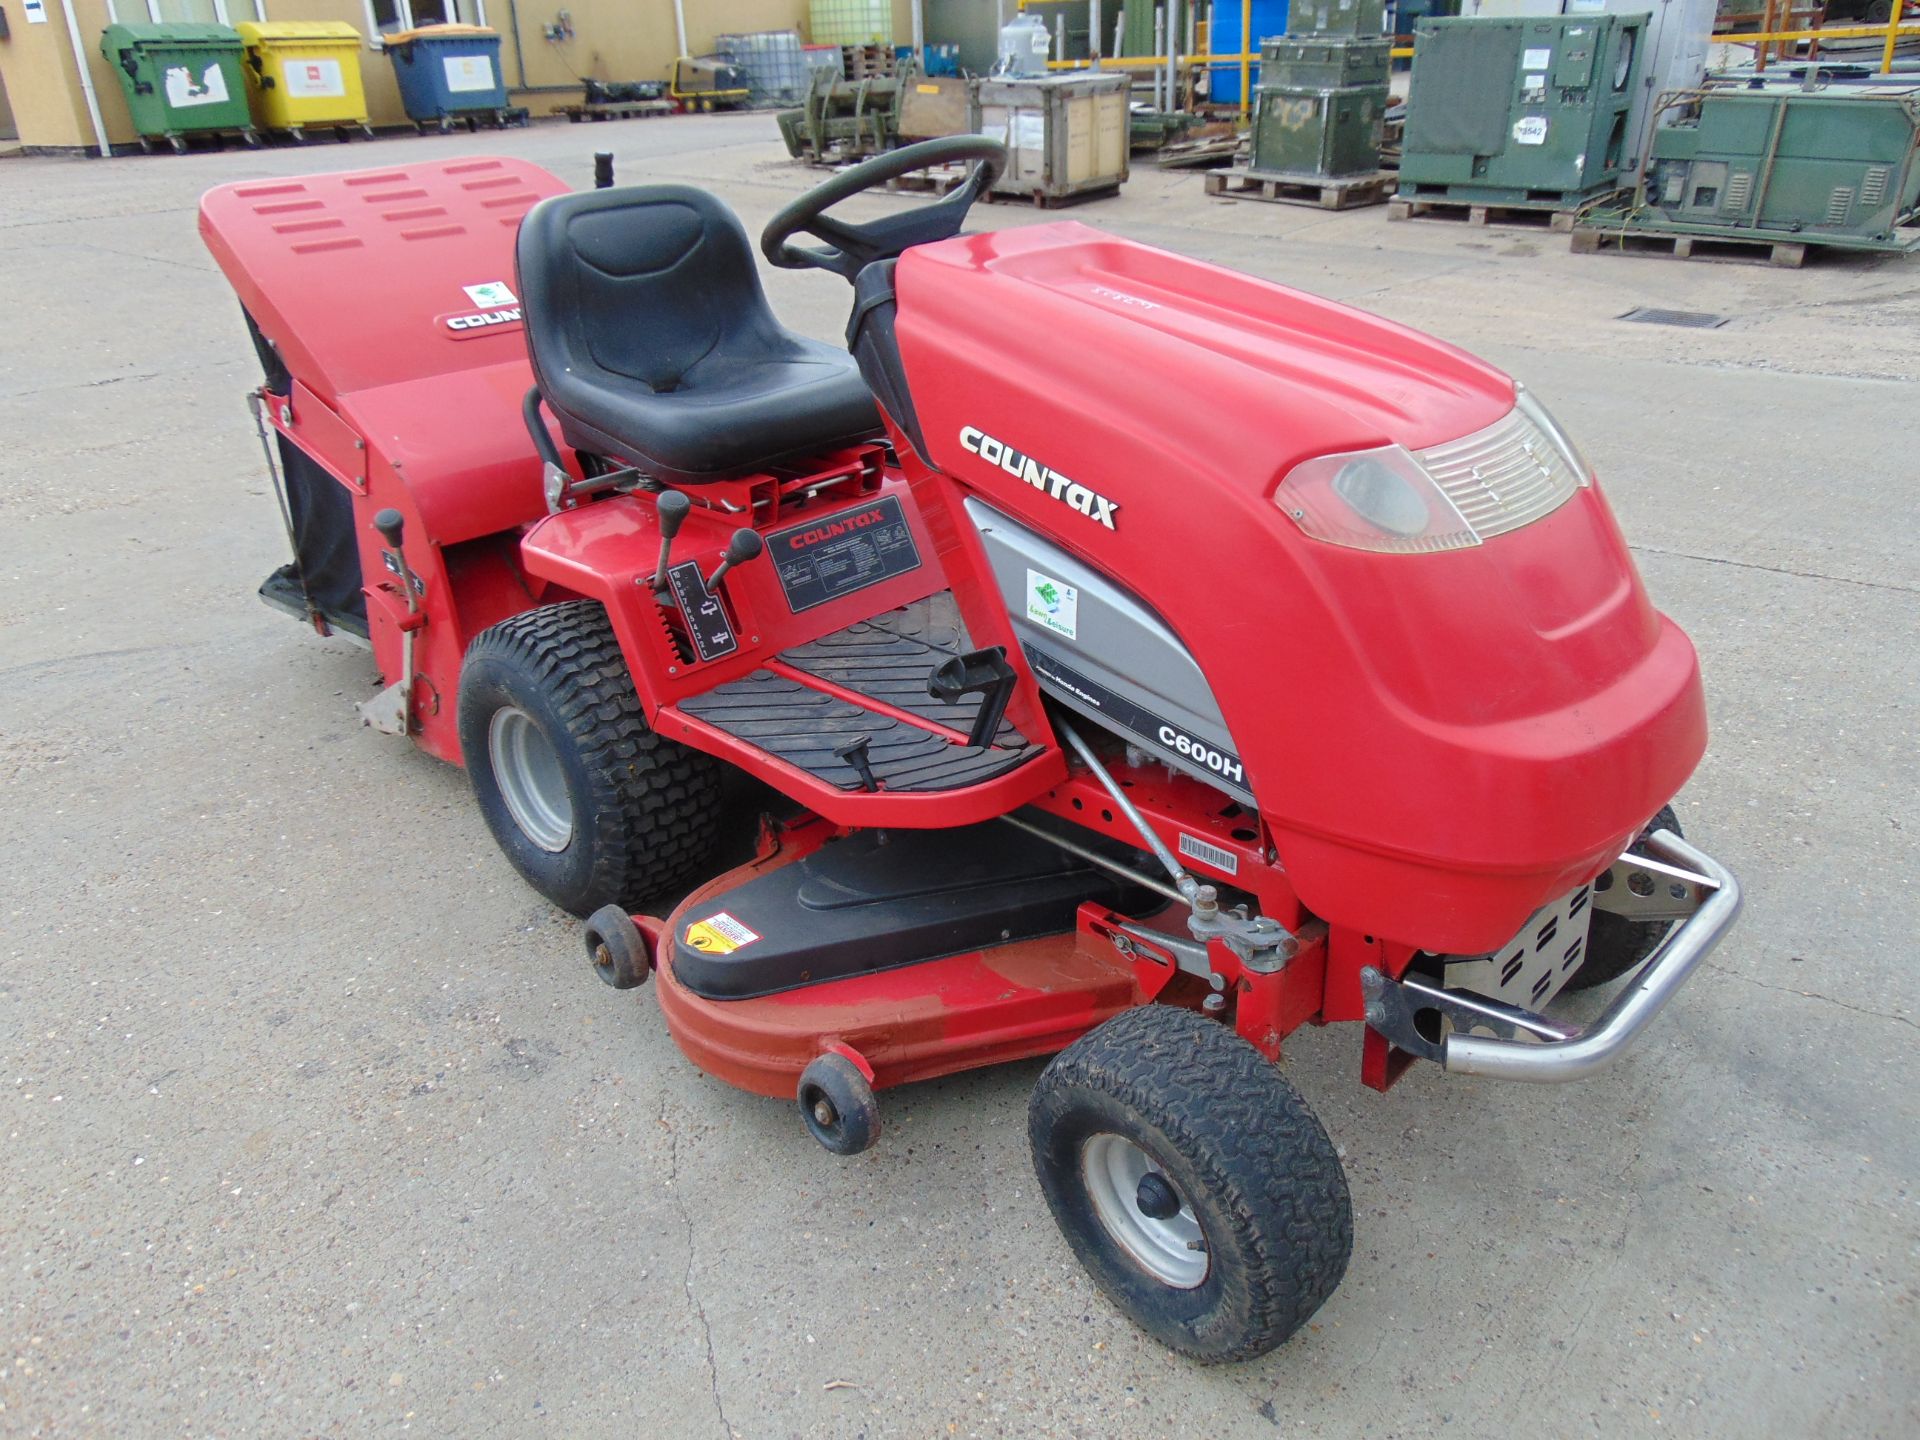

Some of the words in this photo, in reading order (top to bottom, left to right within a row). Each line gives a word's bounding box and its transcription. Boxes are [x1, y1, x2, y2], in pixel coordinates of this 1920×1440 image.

[446, 308, 522, 331] COUN
[959, 424, 1120, 530] COUNTAX
[789, 508, 885, 550] COUNTAX
[1055, 676, 1075, 692] Honda
[1075, 688, 1101, 706] Engines
[1158, 725, 1243, 783] C600H
